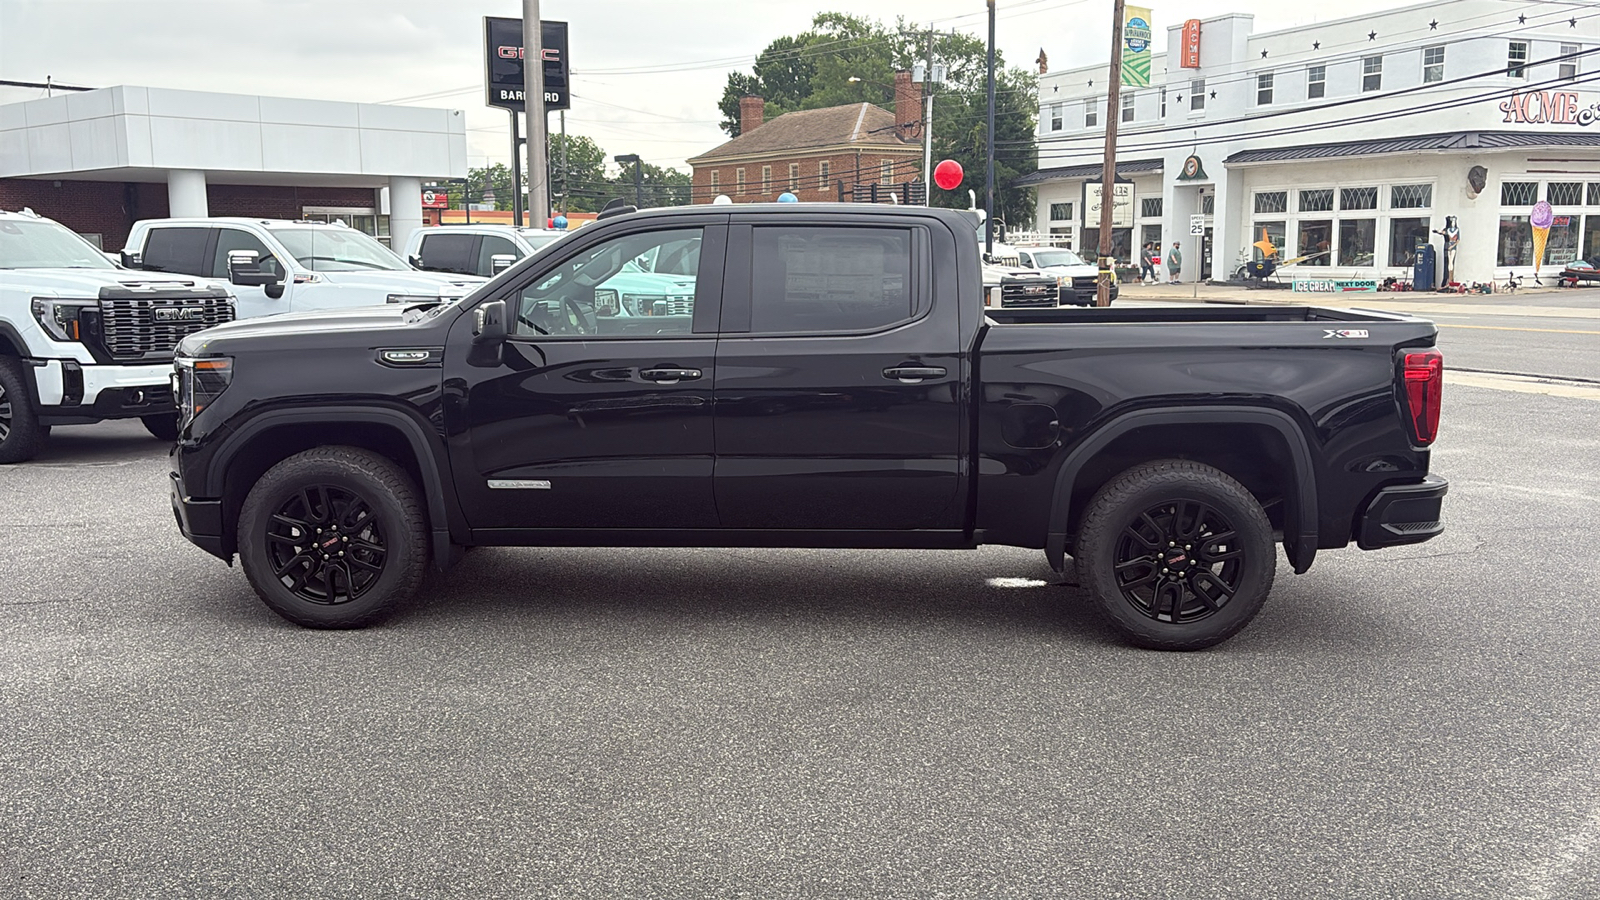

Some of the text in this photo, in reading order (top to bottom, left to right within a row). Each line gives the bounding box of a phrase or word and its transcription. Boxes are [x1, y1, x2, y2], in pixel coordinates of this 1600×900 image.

[1189, 23, 1198, 64] ACME
[498, 45, 560, 61] GC
[500, 90, 559, 102] BARRD
[1499, 89, 1579, 124] ACME
[1191, 225, 1203, 234] 25
[1295, 281, 1308, 292] ICE
[1309, 281, 1336, 292] CREAM
[155, 308, 203, 320] GMC
